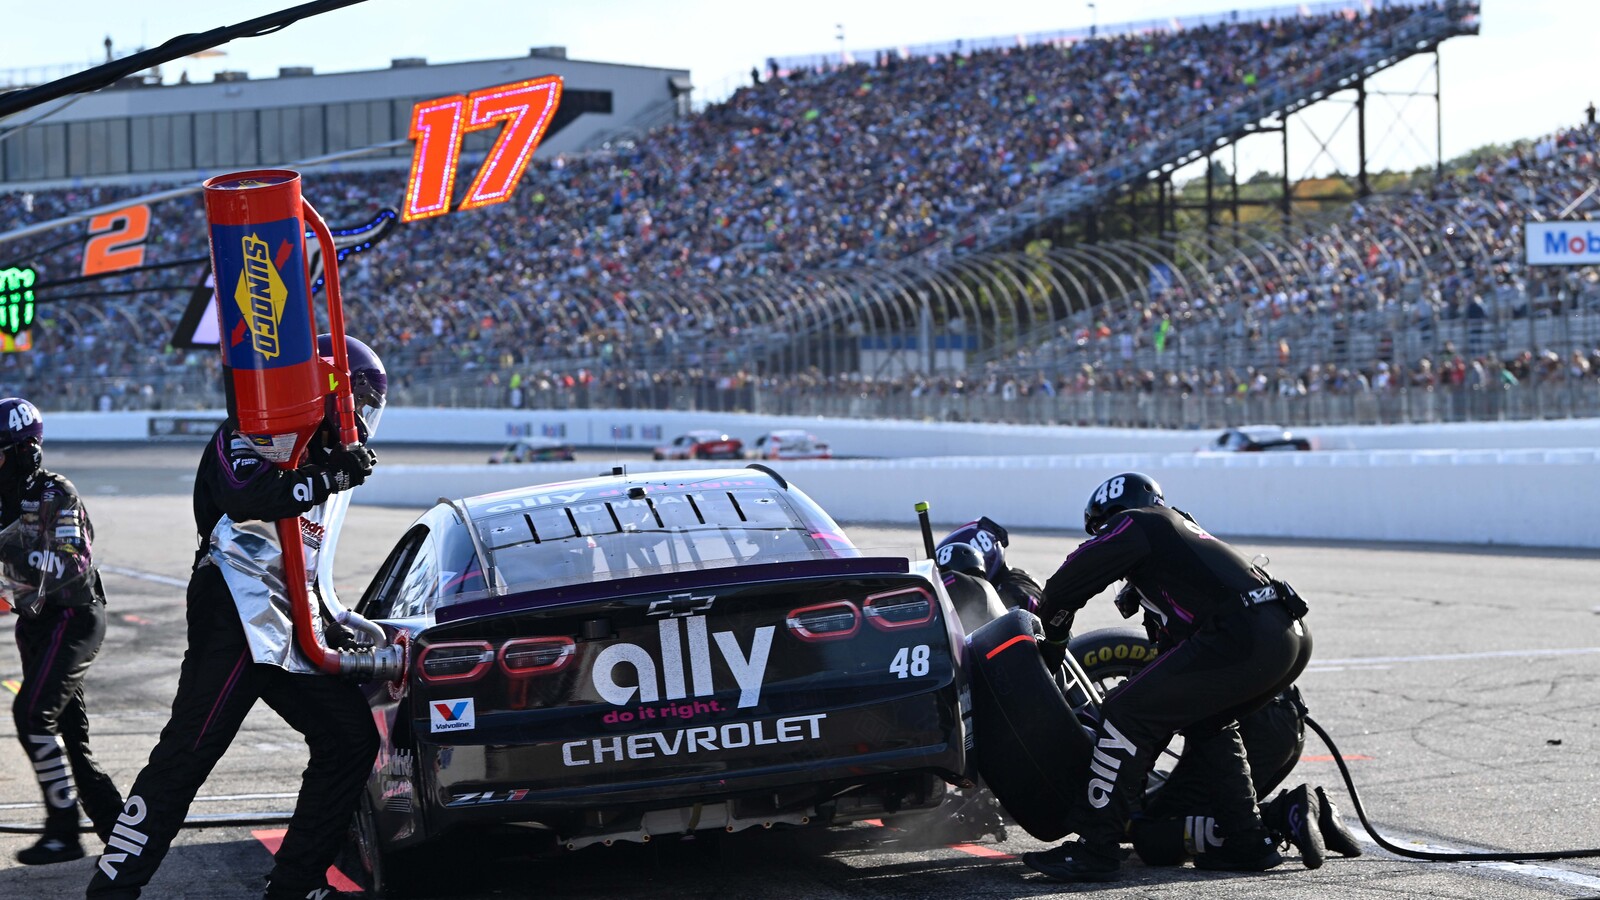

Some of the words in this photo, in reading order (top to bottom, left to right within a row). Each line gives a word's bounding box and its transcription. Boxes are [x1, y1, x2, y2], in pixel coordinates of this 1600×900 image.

[402, 74, 564, 223] 17
[82, 203, 150, 277] 2
[244, 237, 279, 355] SUNOCO
[8, 403, 34, 432] 48
[292, 476, 314, 502] al
[486, 491, 586, 513] ally
[1095, 476, 1126, 505] 48
[558, 494, 705, 517] BOWMAN
[28, 550, 66, 579] ally
[936, 545, 954, 566] 8
[592, 615, 776, 709] ally
[889, 644, 930, 679] 48
[1083, 644, 1147, 667] GOOD
[603, 709, 634, 724] do
[639, 706, 655, 721] it
[661, 699, 727, 719] right.
[435, 722, 471, 731] Valvoline
[562, 713, 828, 767] CHEVROLET
[1088, 719, 1138, 809] ally
[446, 788, 530, 807] ZL1
